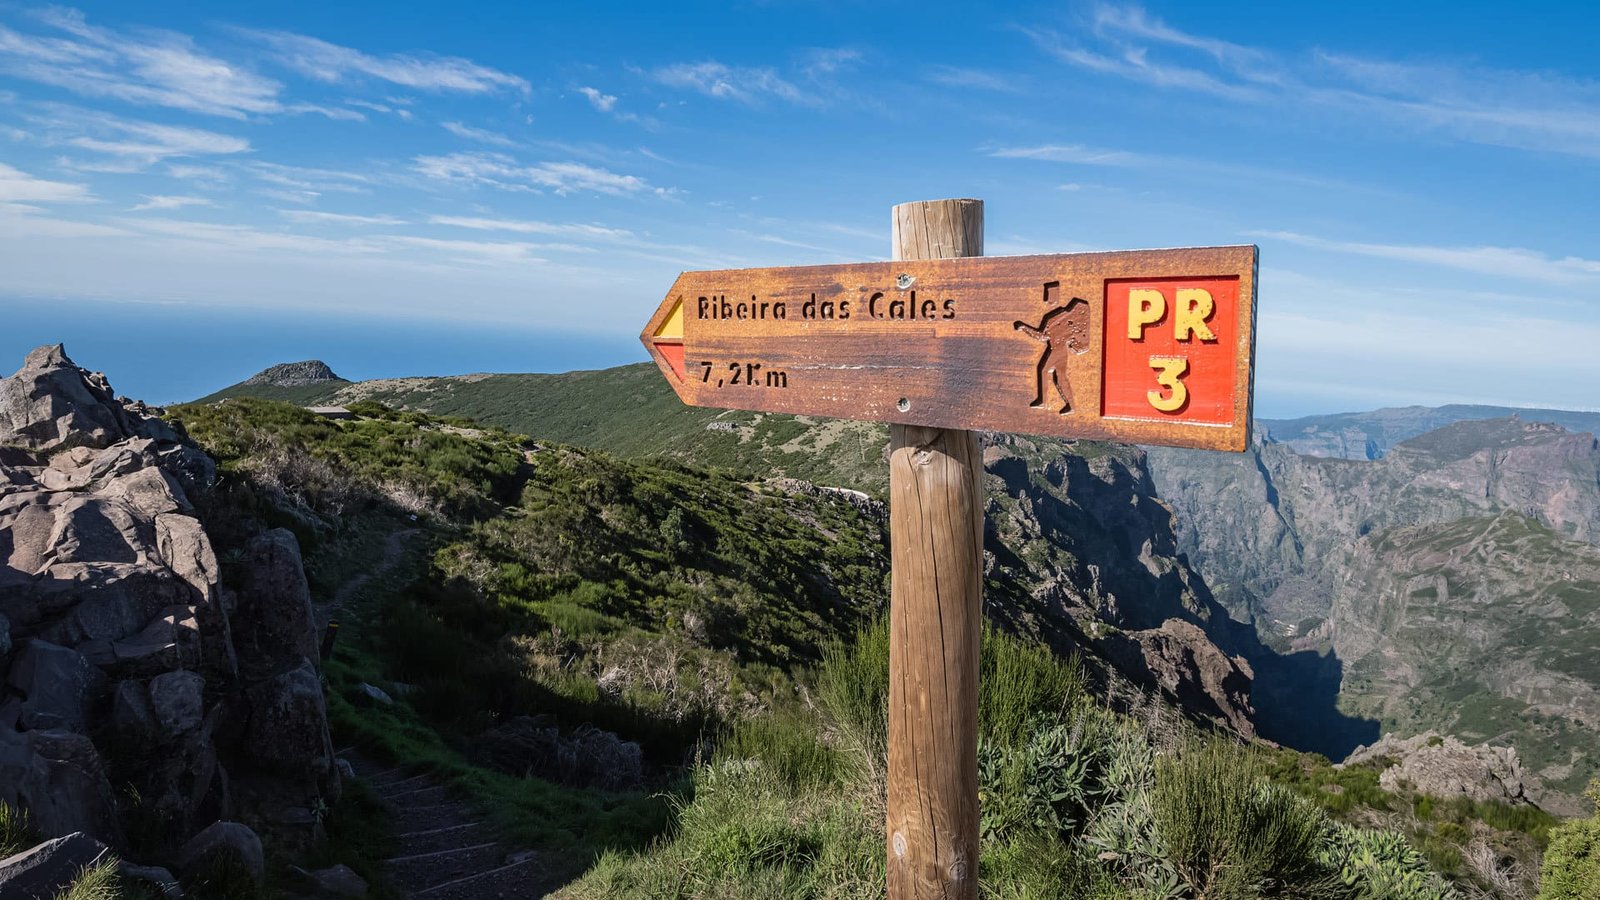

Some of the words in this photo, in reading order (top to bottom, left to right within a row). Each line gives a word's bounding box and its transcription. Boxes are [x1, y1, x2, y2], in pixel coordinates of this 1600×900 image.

[698, 295, 787, 320] Ribeira
[802, 293, 850, 319] das
[869, 290, 956, 320] Cales
[1127, 288, 1217, 341] PR
[1147, 356, 1189, 411] 3
